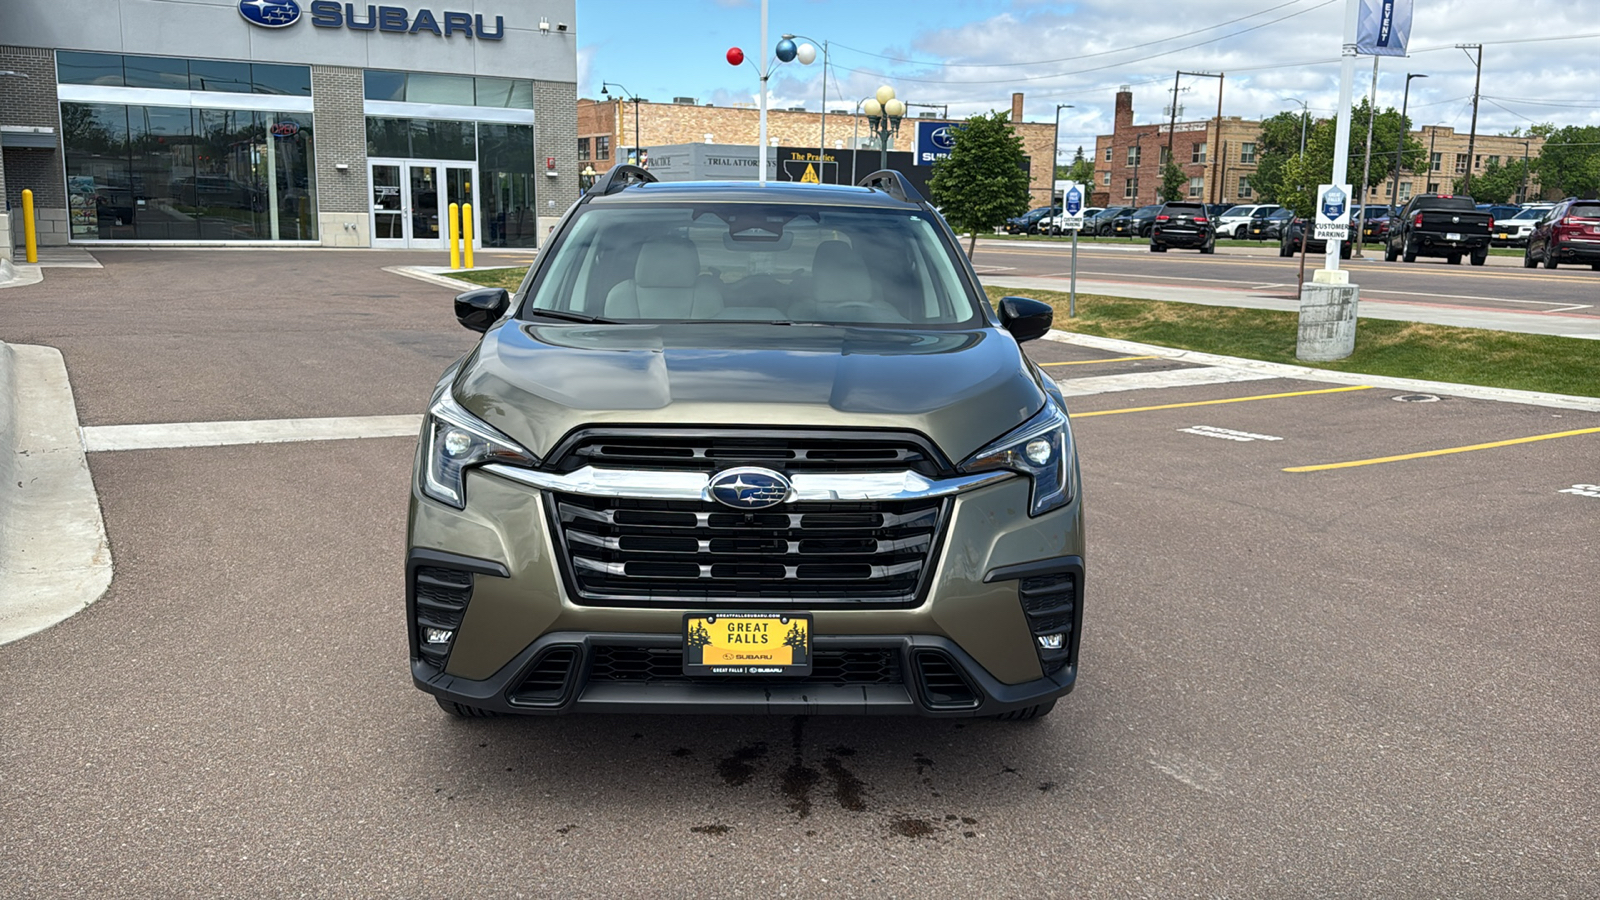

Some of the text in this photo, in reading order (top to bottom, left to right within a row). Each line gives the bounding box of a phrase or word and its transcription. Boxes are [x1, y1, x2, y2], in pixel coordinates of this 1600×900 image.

[311, 0, 504, 40] SUBARU
[1381, 3, 1391, 42] EVENT
[271, 123, 297, 134] OPEN
[791, 152, 805, 160] The
[707, 158, 777, 167] TRIAL ATTORYS
[727, 622, 769, 632] GREAT
[727, 633, 769, 644] FALLS
